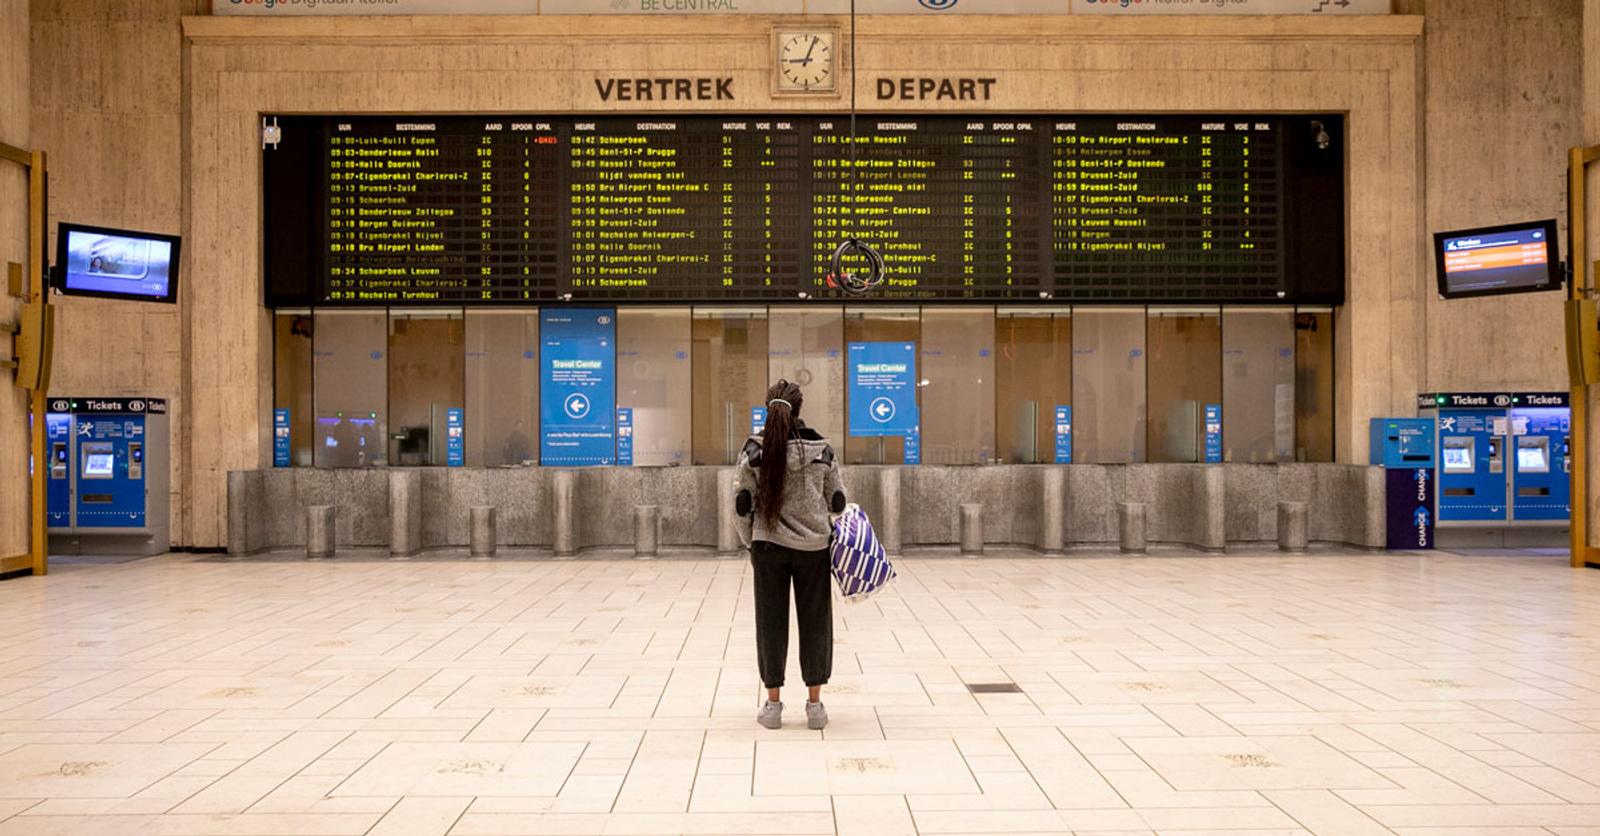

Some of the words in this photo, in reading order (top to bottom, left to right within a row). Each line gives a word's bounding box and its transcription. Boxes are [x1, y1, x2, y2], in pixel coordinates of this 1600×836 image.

[595, 78, 734, 100] VERTREK
[877, 78, 996, 100] DEPART
[552, 360, 574, 368] Travel
[575, 360, 602, 368] Center
[857, 364, 880, 372] Travel
[880, 364, 906, 372] Center
[1452, 396, 1488, 405] Tickets
[1527, 395, 1562, 404] Tickets
[86, 401, 122, 410] Tickets
